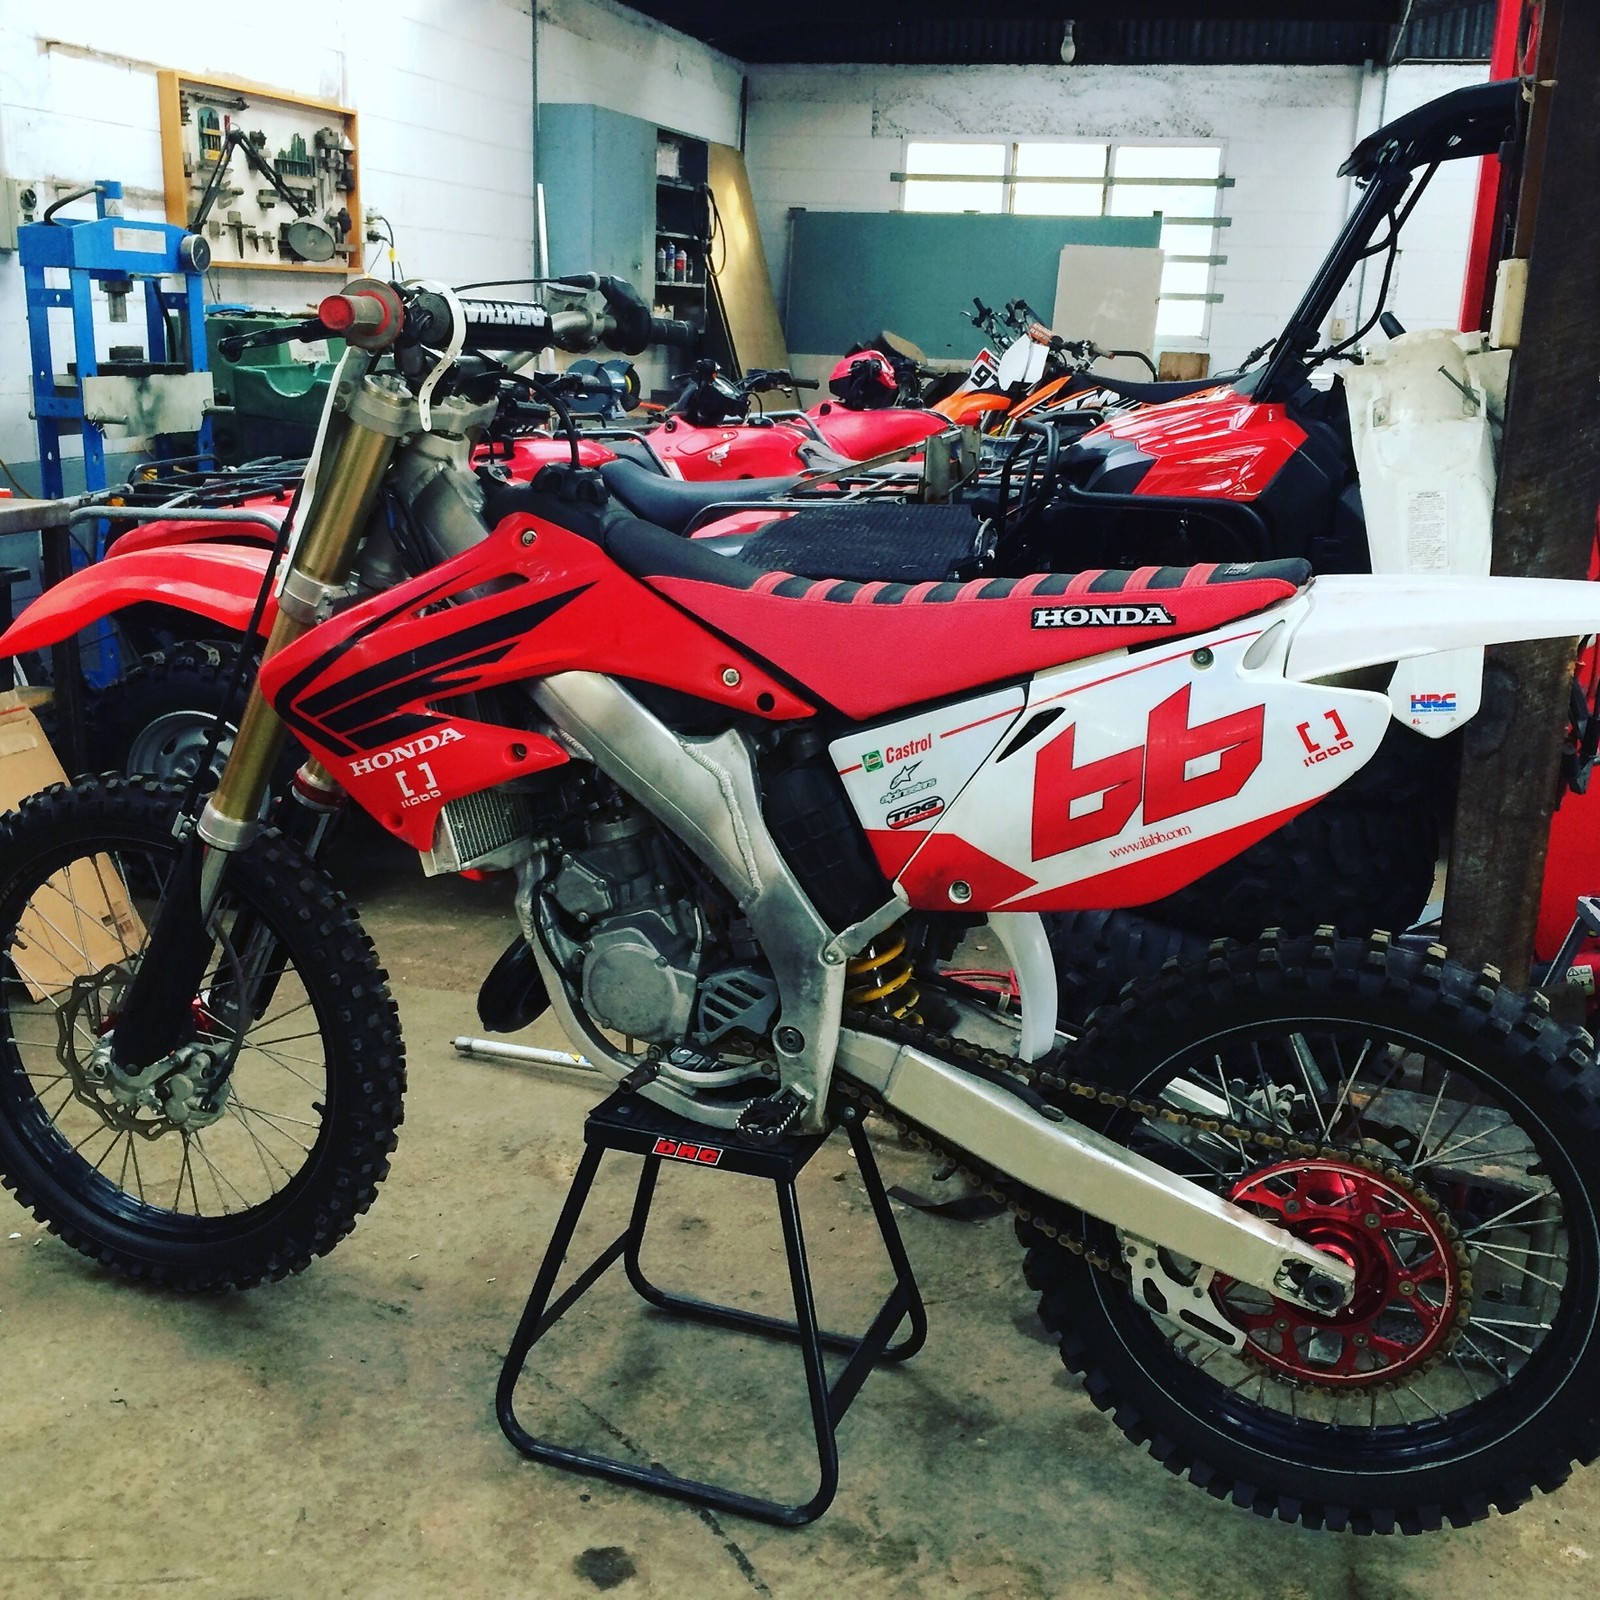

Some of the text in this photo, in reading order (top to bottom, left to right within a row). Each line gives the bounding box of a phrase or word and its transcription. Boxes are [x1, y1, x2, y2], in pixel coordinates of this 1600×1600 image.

[461, 302, 547, 327] RENTHA
[1034, 606, 1172, 627] HONDA
[1411, 693, 1456, 709] HRC
[349, 727, 466, 776] HONDA
[885, 733, 932, 764] Castrol
[888, 800, 938, 822] TAG
[1109, 824, 1192, 858] www.ilabb.com
[655, 1140, 719, 1163] DRC
